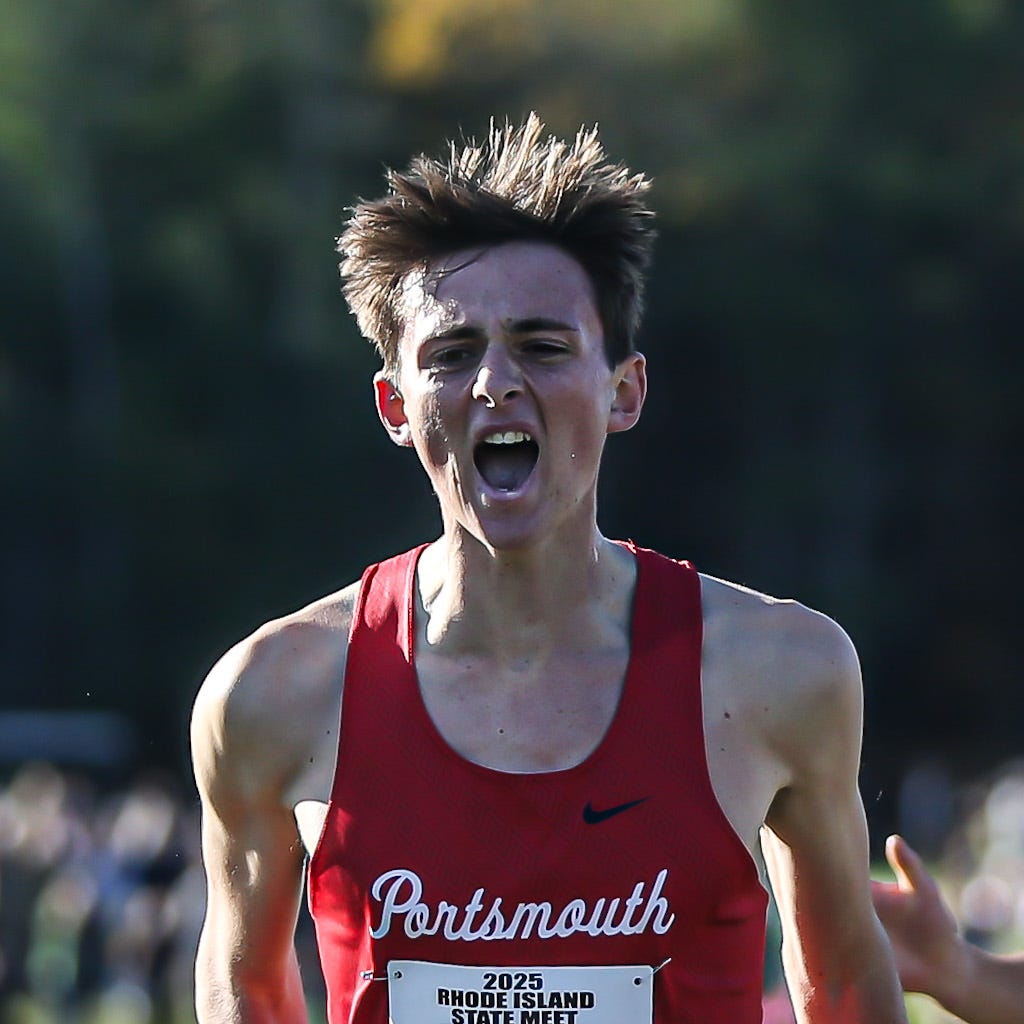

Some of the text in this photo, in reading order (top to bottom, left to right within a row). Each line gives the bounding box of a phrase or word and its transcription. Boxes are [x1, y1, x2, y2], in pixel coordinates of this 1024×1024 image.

[369, 869, 675, 941] Portsmouth
[482, 972, 544, 991] 2025
[437, 988, 595, 1009] RHODE ISLAND
